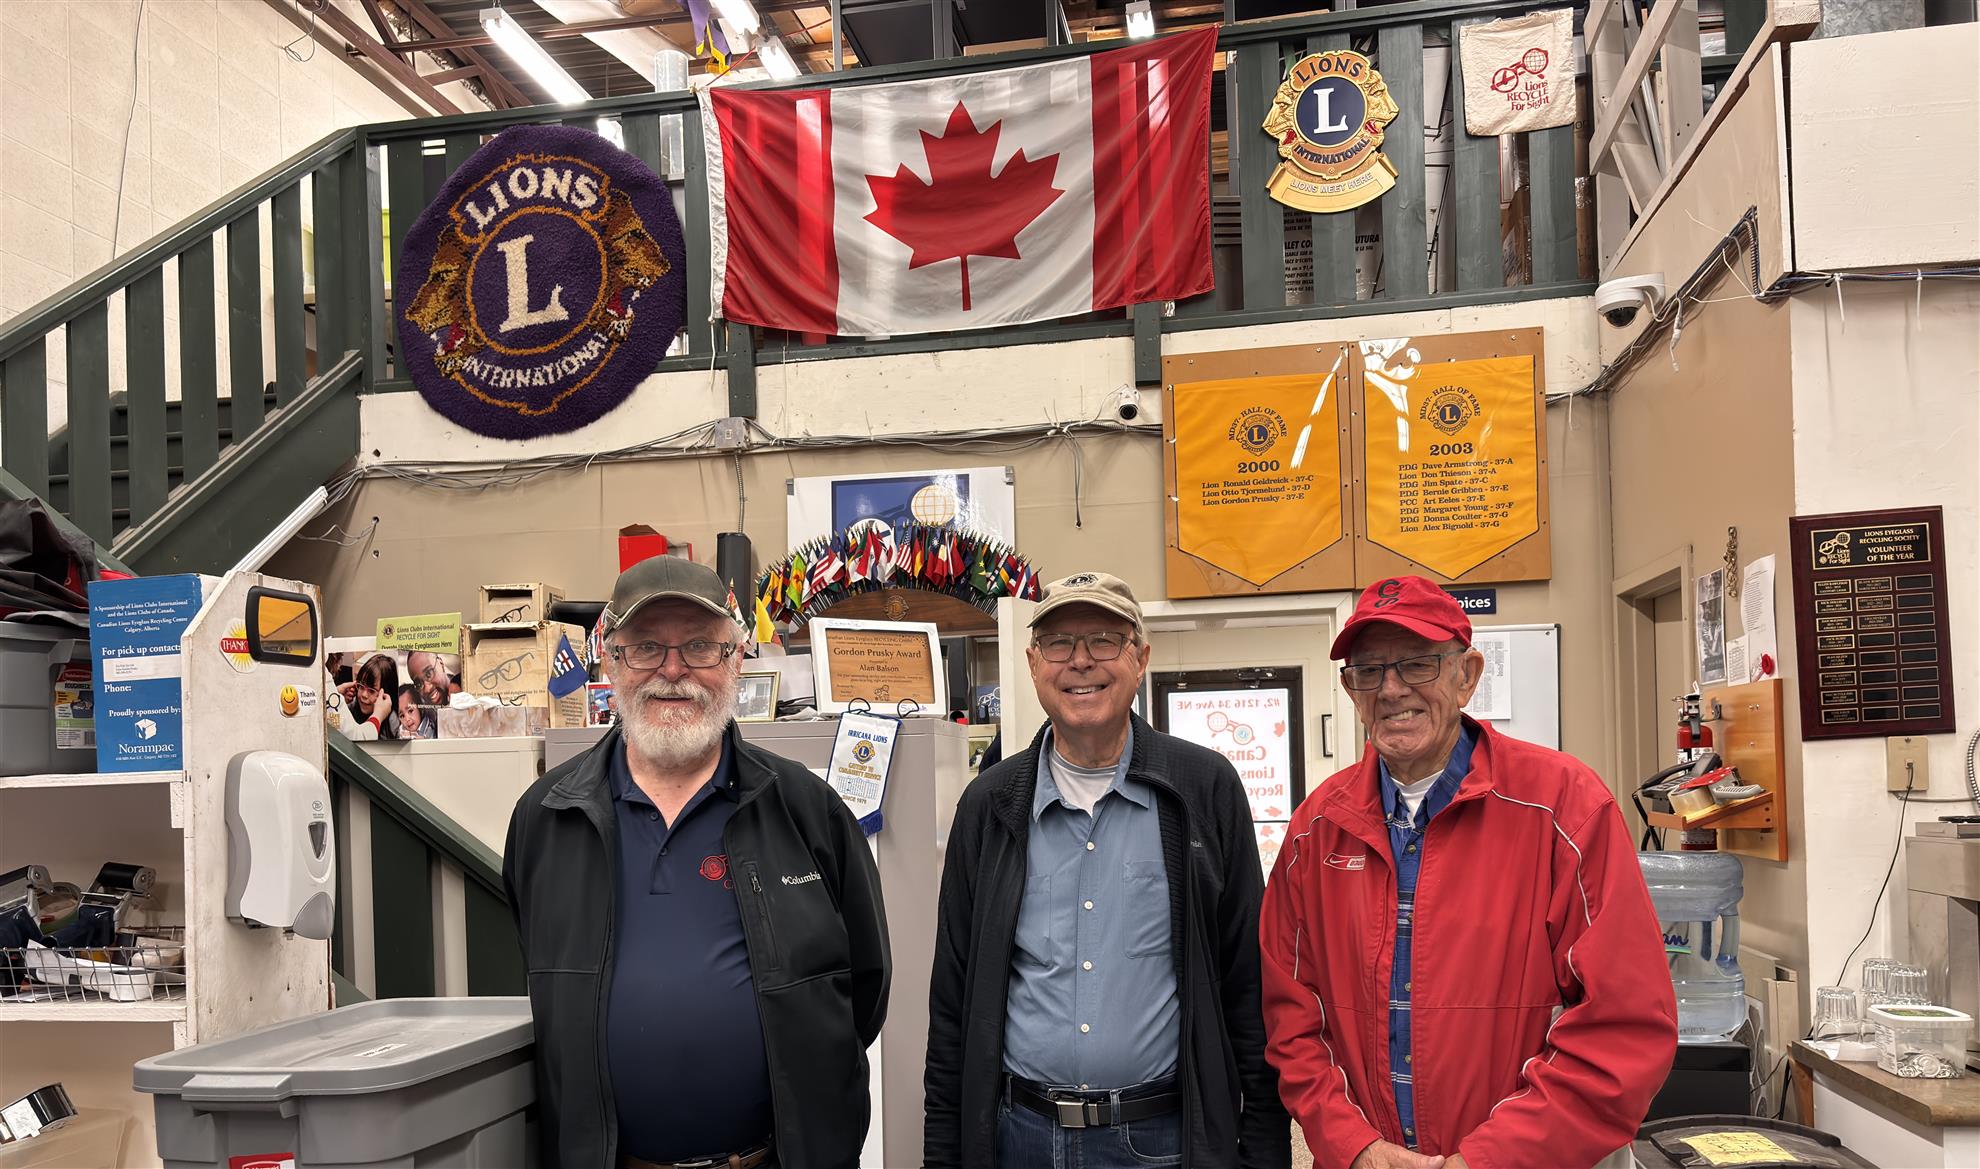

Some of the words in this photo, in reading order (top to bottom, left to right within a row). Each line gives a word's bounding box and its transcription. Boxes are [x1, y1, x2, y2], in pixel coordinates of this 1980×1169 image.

[1296, 57, 1364, 83] LIONS
[1525, 81, 1548, 91] Lions
[1507, 88, 1548, 101] RECYCLE
[1511, 102, 1525, 110] For
[1526, 96, 1550, 109] Sight
[1313, 88, 1348, 134] L
[1294, 138, 1370, 164] INTERNATIONAL
[1290, 179, 1318, 193] LIONS
[1320, 184, 1346, 194] MEET
[1348, 172, 1374, 188] HERE
[464, 167, 599, 229] LIONS
[497, 234, 569, 332] L
[1432, 386, 1456, 396] HALL
[1456, 386, 1470, 395] OF
[1468, 392, 1480, 416] FAME
[1241, 406, 1262, 418] HALL
[1264, 408, 1276, 416] OF
[1274, 415, 1288, 438] FAME
[1430, 442, 1473, 456] 2003
[1238, 460, 1280, 474] 2000
[1296, 474, 1314, 482] 37-C
[1221, 489, 1240, 497] Otto
[1222, 497, 1250, 505] Gordon
[1252, 495, 1280, 504] Prusky
[1424, 506, 1461, 514] Margaret
[1868, 545, 1912, 553] VOLUNTEER
[102, 647, 116, 656] For
[117, 645, 134, 656] pick
[223, 640, 247, 650] THANK
[414, 642, 440, 650] Eyeglasses
[834, 648, 865, 656] Gordon
[867, 649, 893, 659] Prusky
[104, 684, 131, 692] Phone:
[109, 709, 135, 717] Proudly
[136, 706, 168, 716] sponsored
[170, 706, 181, 715] by:
[848, 730, 871, 740] IRRICANA
[872, 734, 888, 744] LIONS
[119, 744, 174, 754] Norampac
[787, 871, 821, 885] Columbia
